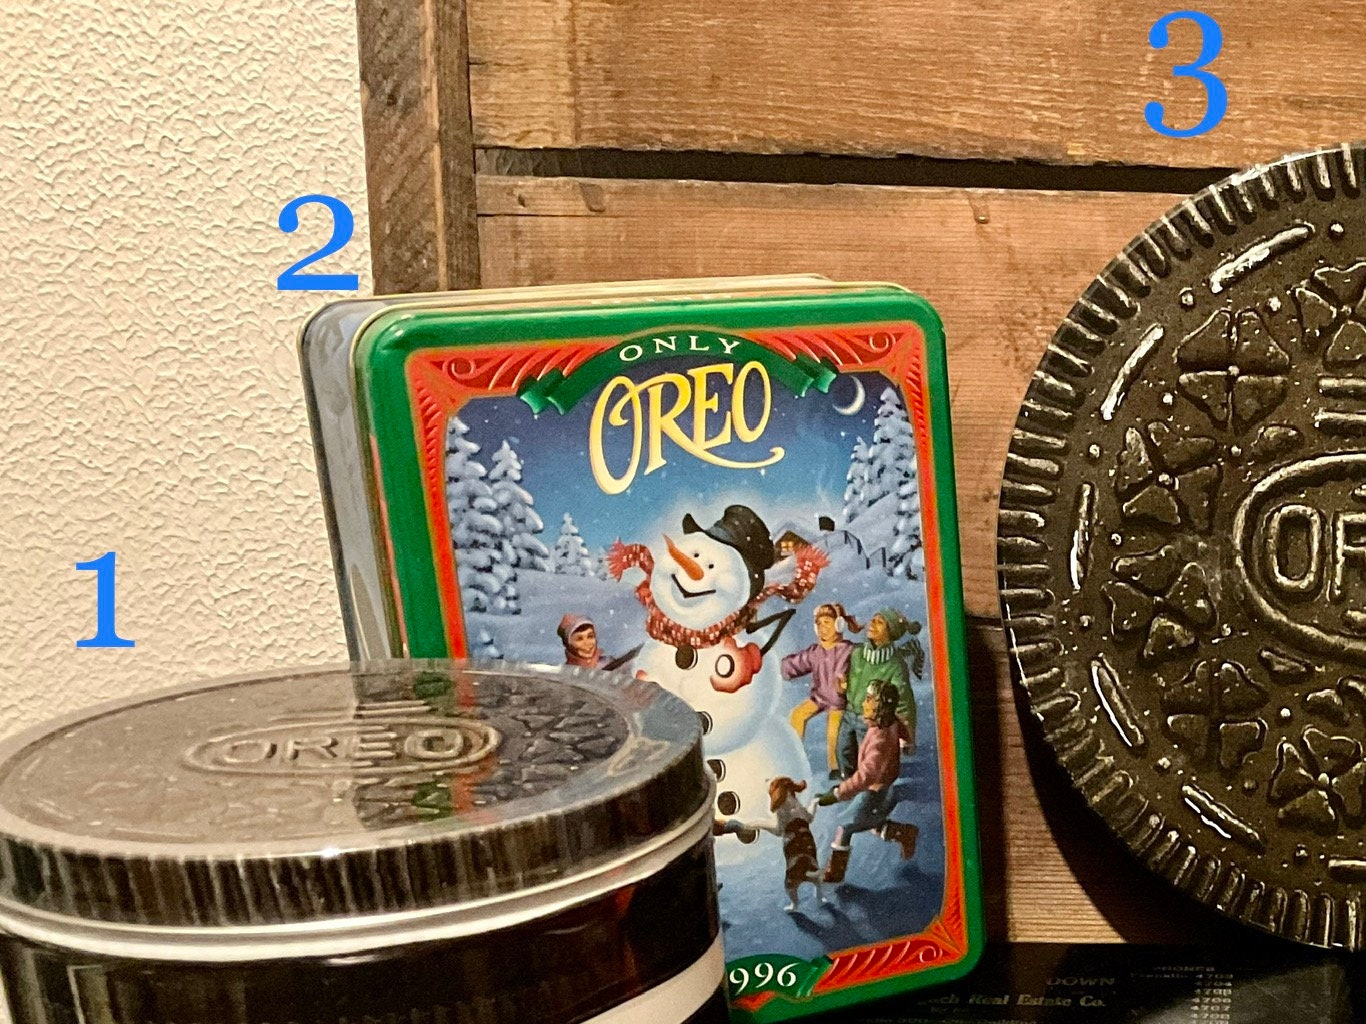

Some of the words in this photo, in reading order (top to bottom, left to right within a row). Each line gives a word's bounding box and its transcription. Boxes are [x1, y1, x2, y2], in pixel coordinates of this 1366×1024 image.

[619, 335, 740, 362] ONLY
[589, 361, 785, 495] OREO
[223, 729, 465, 765] OREO
[729, 962, 800, 996] 996
